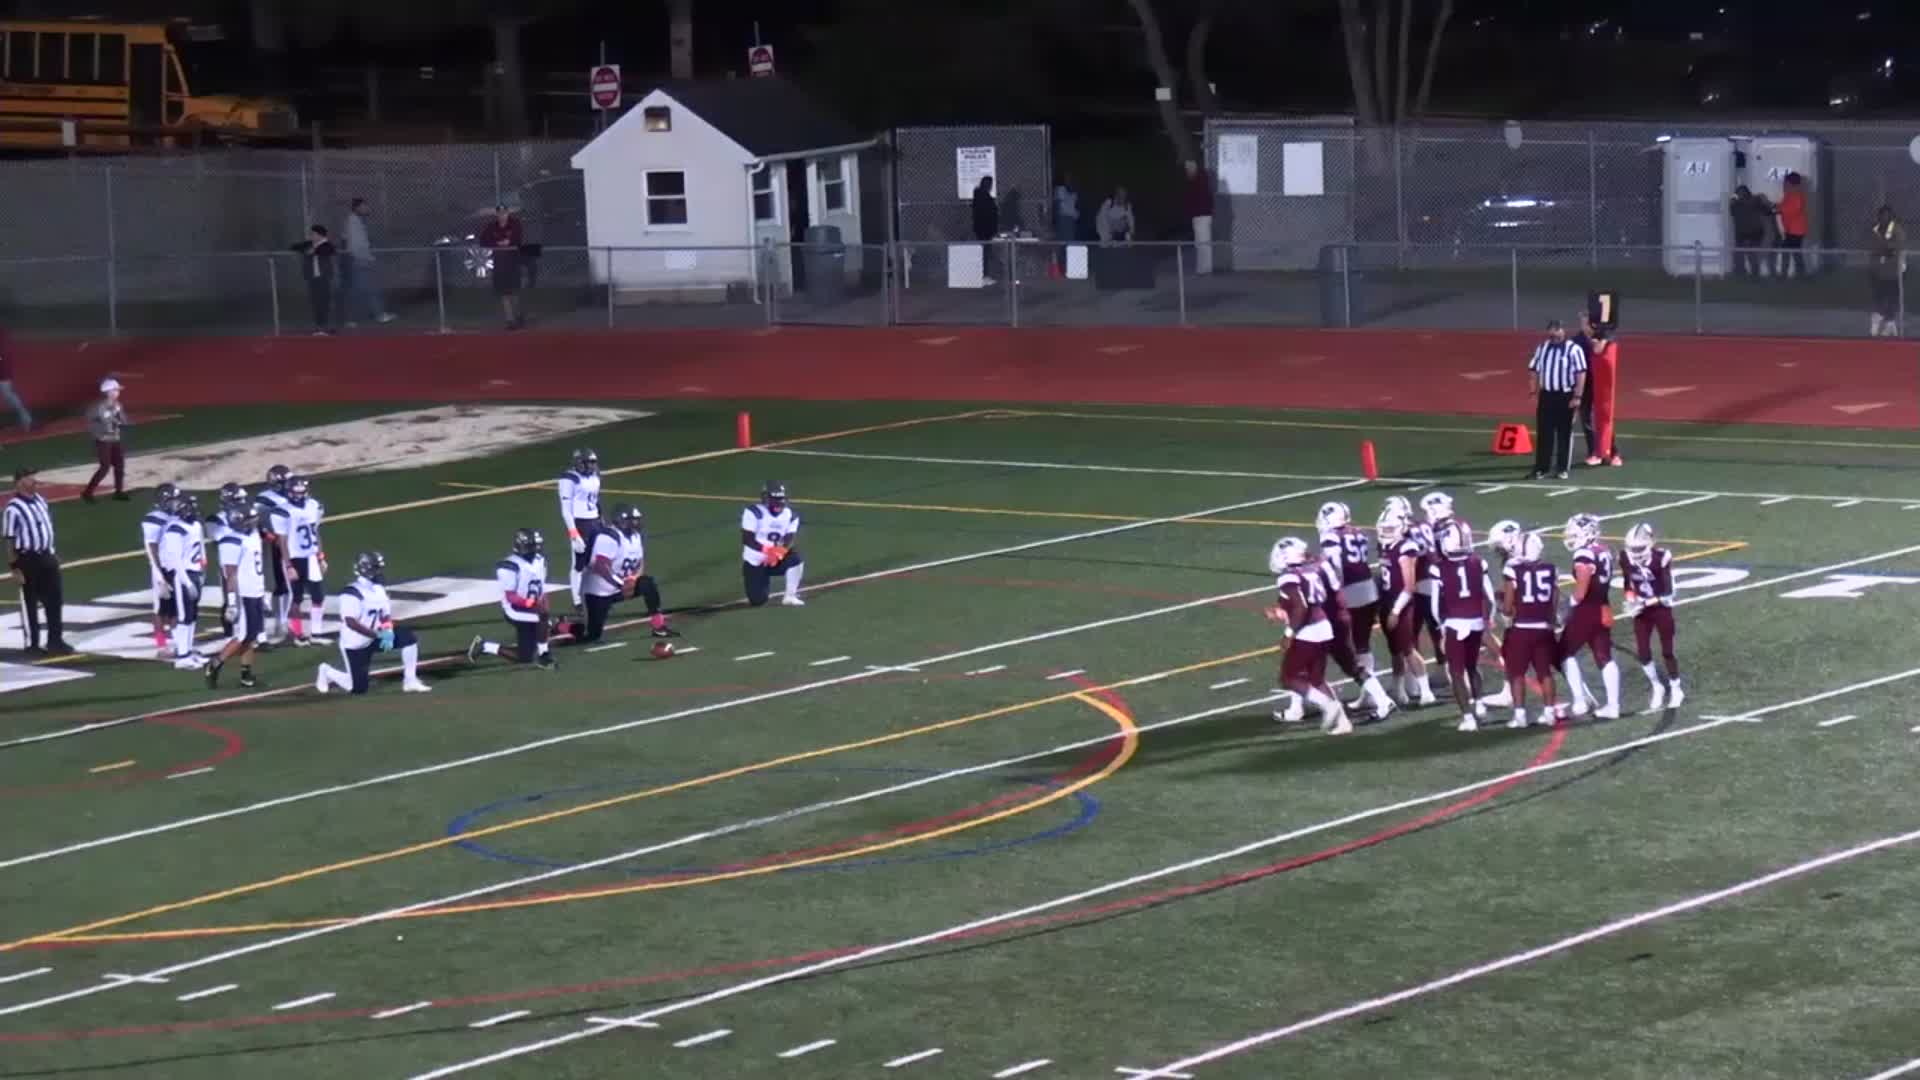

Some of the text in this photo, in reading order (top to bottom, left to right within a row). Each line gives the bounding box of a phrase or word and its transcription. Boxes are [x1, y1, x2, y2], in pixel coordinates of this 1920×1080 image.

[1599, 294, 1611, 323] 1
[1500, 426, 1518, 450] G
[1457, 565, 1471, 599] 1
[1522, 569, 1552, 603] 15
